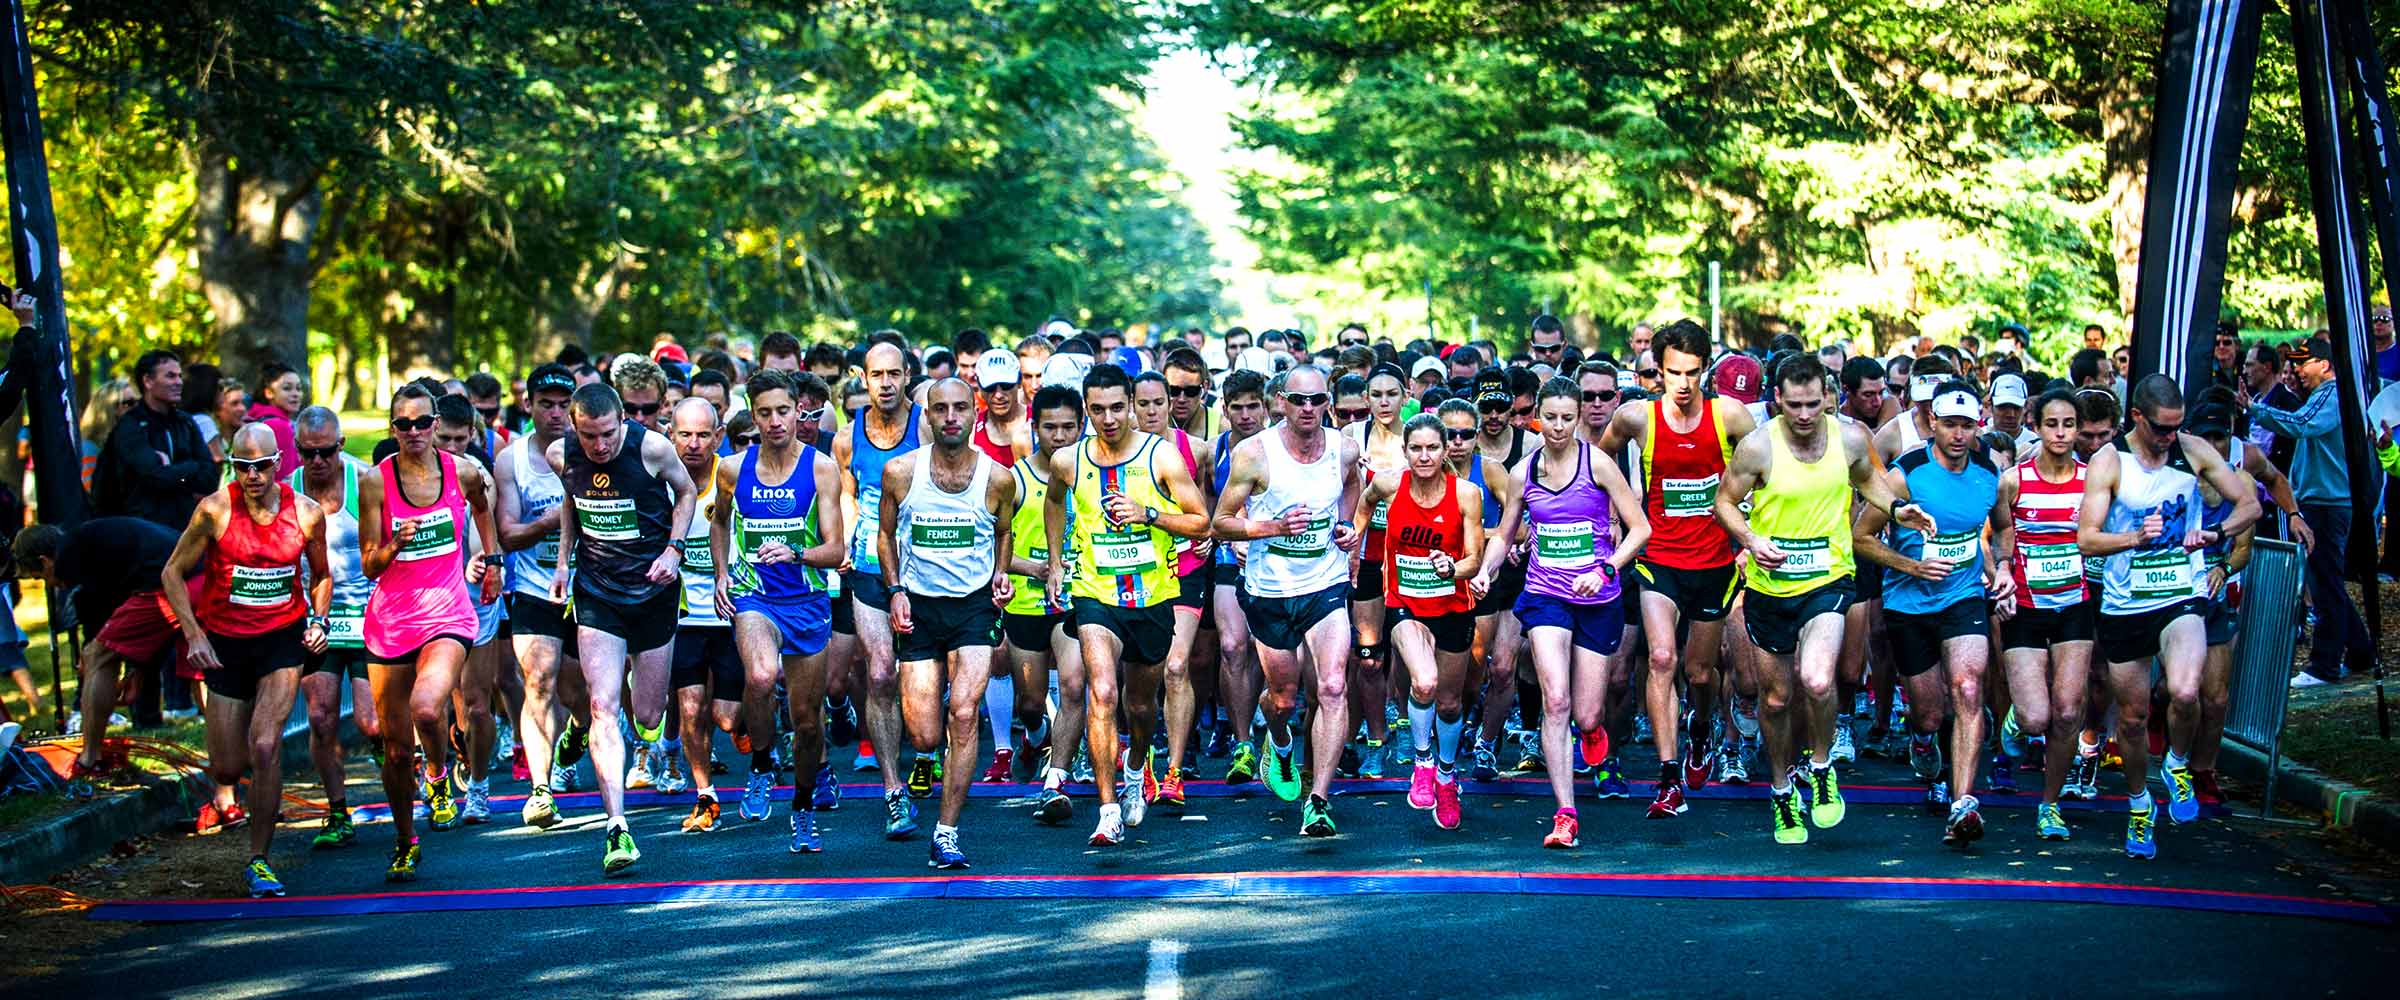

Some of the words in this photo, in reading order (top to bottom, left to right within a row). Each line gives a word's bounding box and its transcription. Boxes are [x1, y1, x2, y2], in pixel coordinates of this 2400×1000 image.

[752, 486, 795, 499] knox
[1680, 492, 1707, 502] GREEN
[589, 514, 622, 524] TOOMEY
[927, 529, 959, 539] FENECH
[1401, 524, 1443, 547] elite
[1547, 539, 1582, 550] MCADAM
[1107, 547, 1138, 559] 10519
[1938, 545, 1966, 557] 10619
[2041, 560, 2071, 573] 10447
[2145, 570, 2177, 583] 10146
[243, 581, 283, 591] JOHNSON
